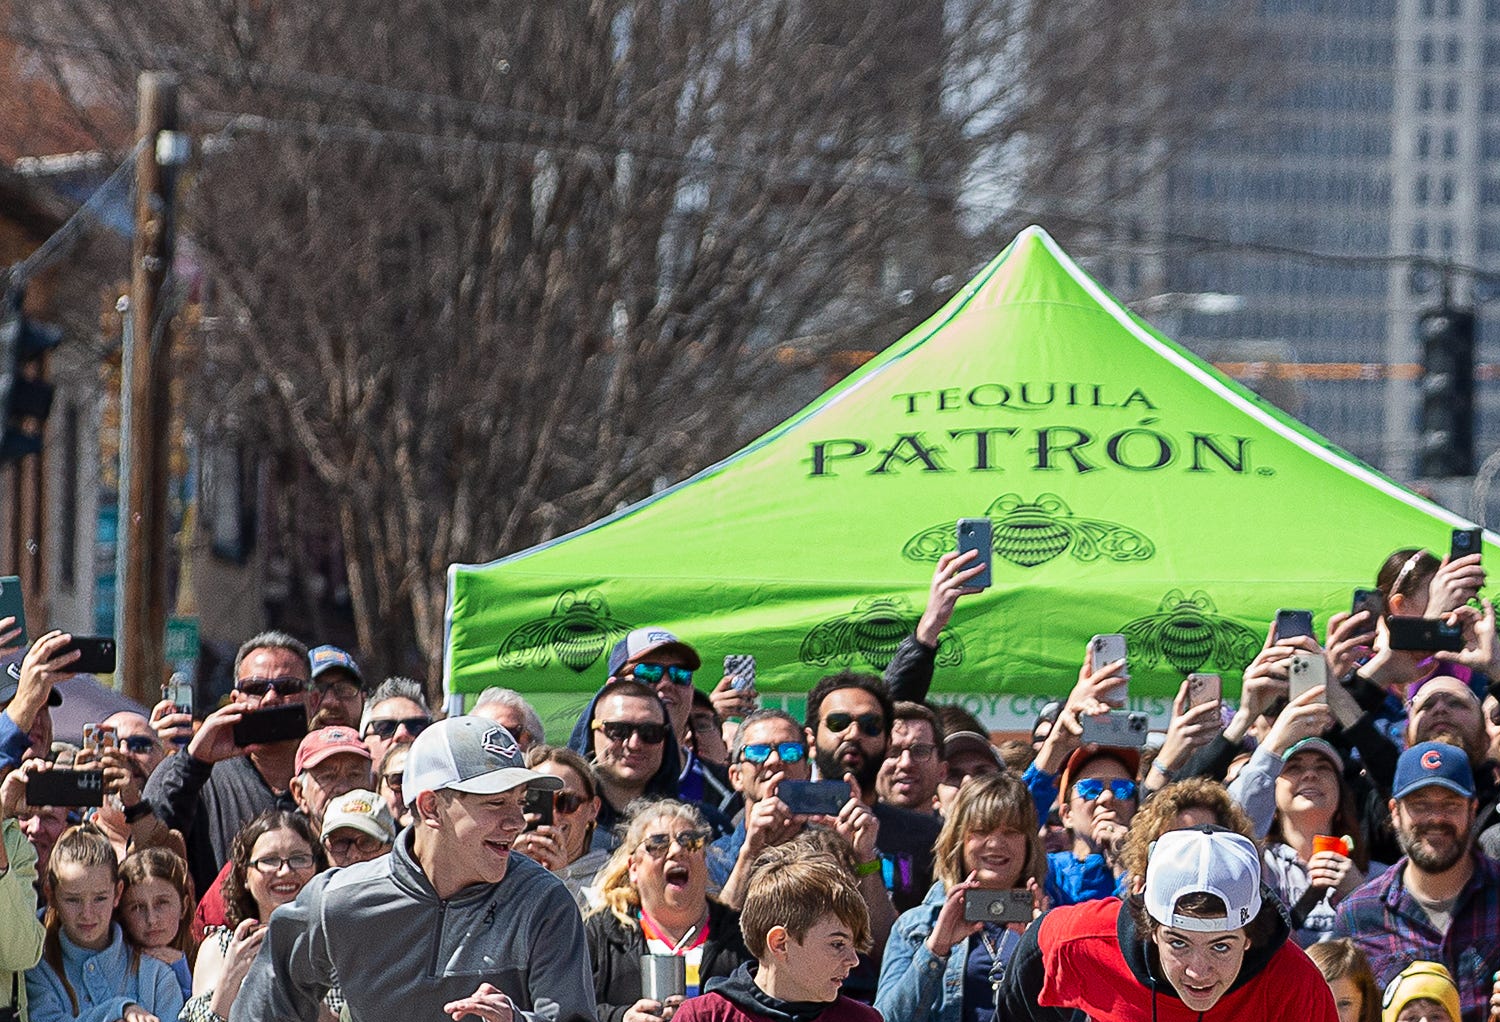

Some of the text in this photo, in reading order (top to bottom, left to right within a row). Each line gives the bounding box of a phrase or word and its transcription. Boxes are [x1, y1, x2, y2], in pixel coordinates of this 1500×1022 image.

[892, 382, 1158, 413] TEQUILA
[801, 416, 1255, 477] PATRÓN
[1420, 750, 1442, 770] C
